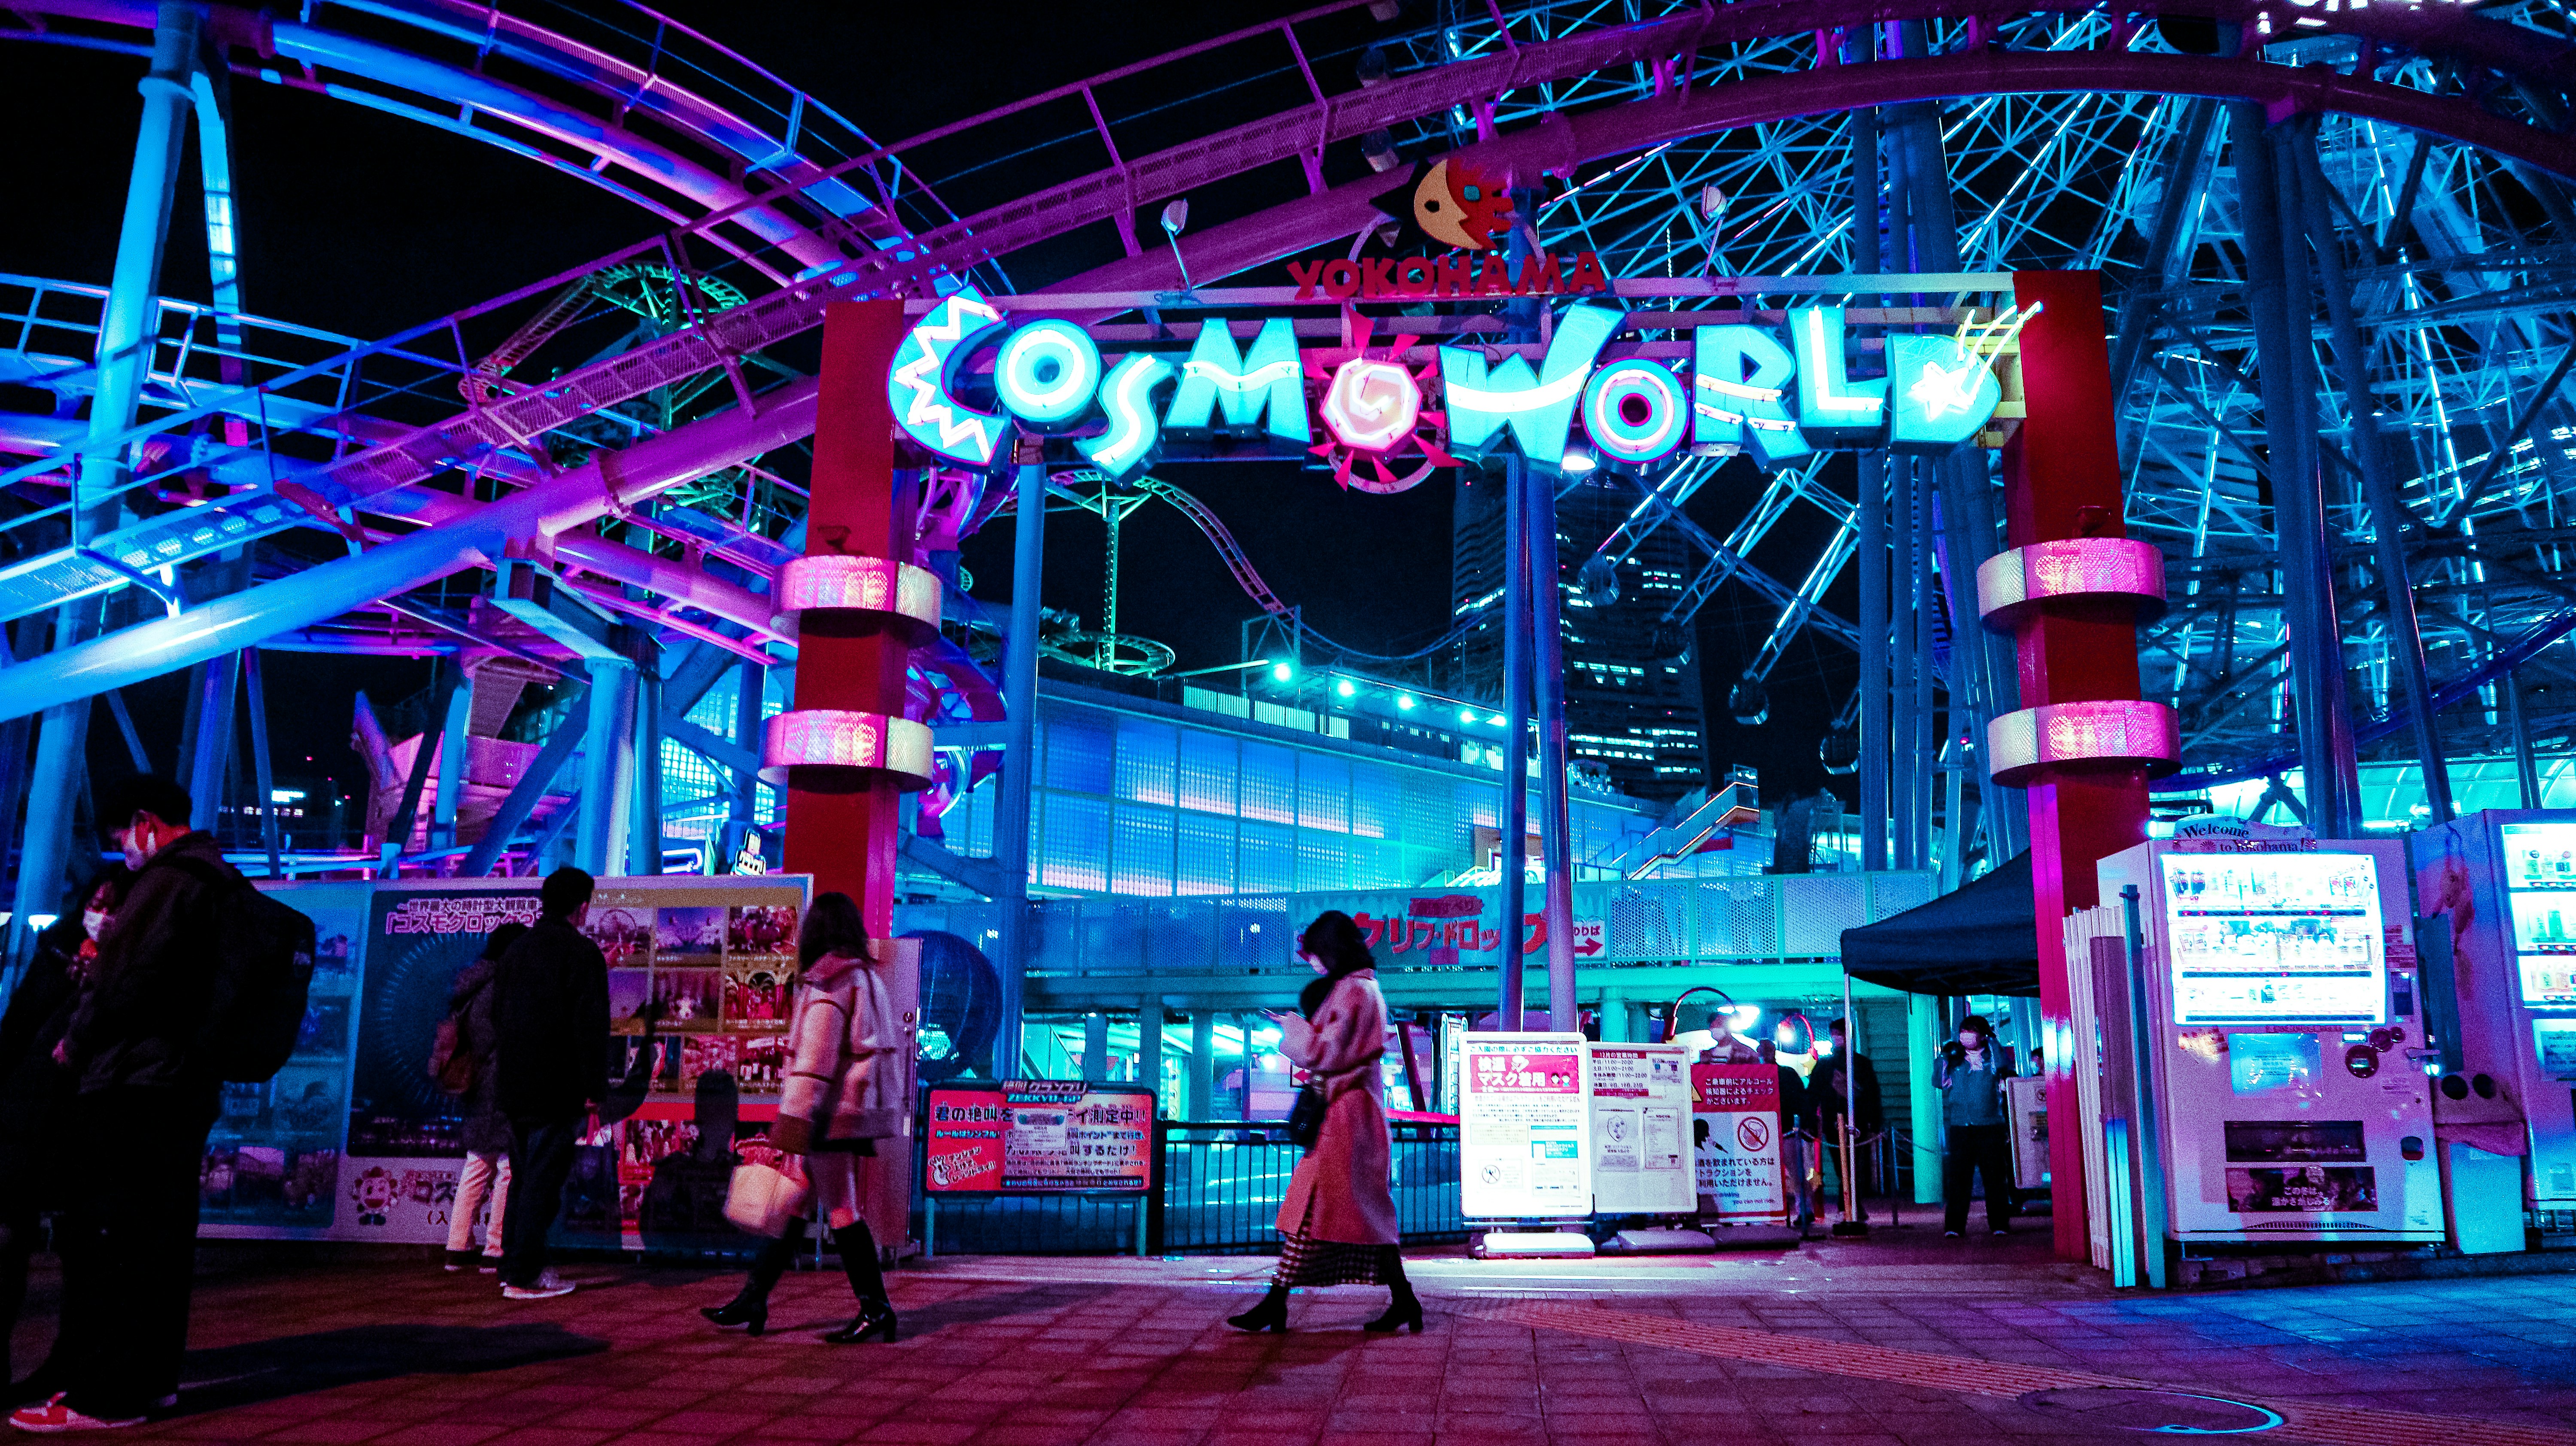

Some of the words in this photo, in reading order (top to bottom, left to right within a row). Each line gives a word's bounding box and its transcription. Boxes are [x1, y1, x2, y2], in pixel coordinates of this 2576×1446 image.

[1287, 252, 1607, 300] YOKOHAMA
[1440, 303, 2002, 468] WORLD
[2183, 823, 2249, 838] Welcome
[2220, 843, 2232, 852] to
[2233, 838, 2304, 852] Yokohama!
[1477, 1072, 1546, 1087] マスク着用
[1699, 1168, 1752, 1177] トラクションを
